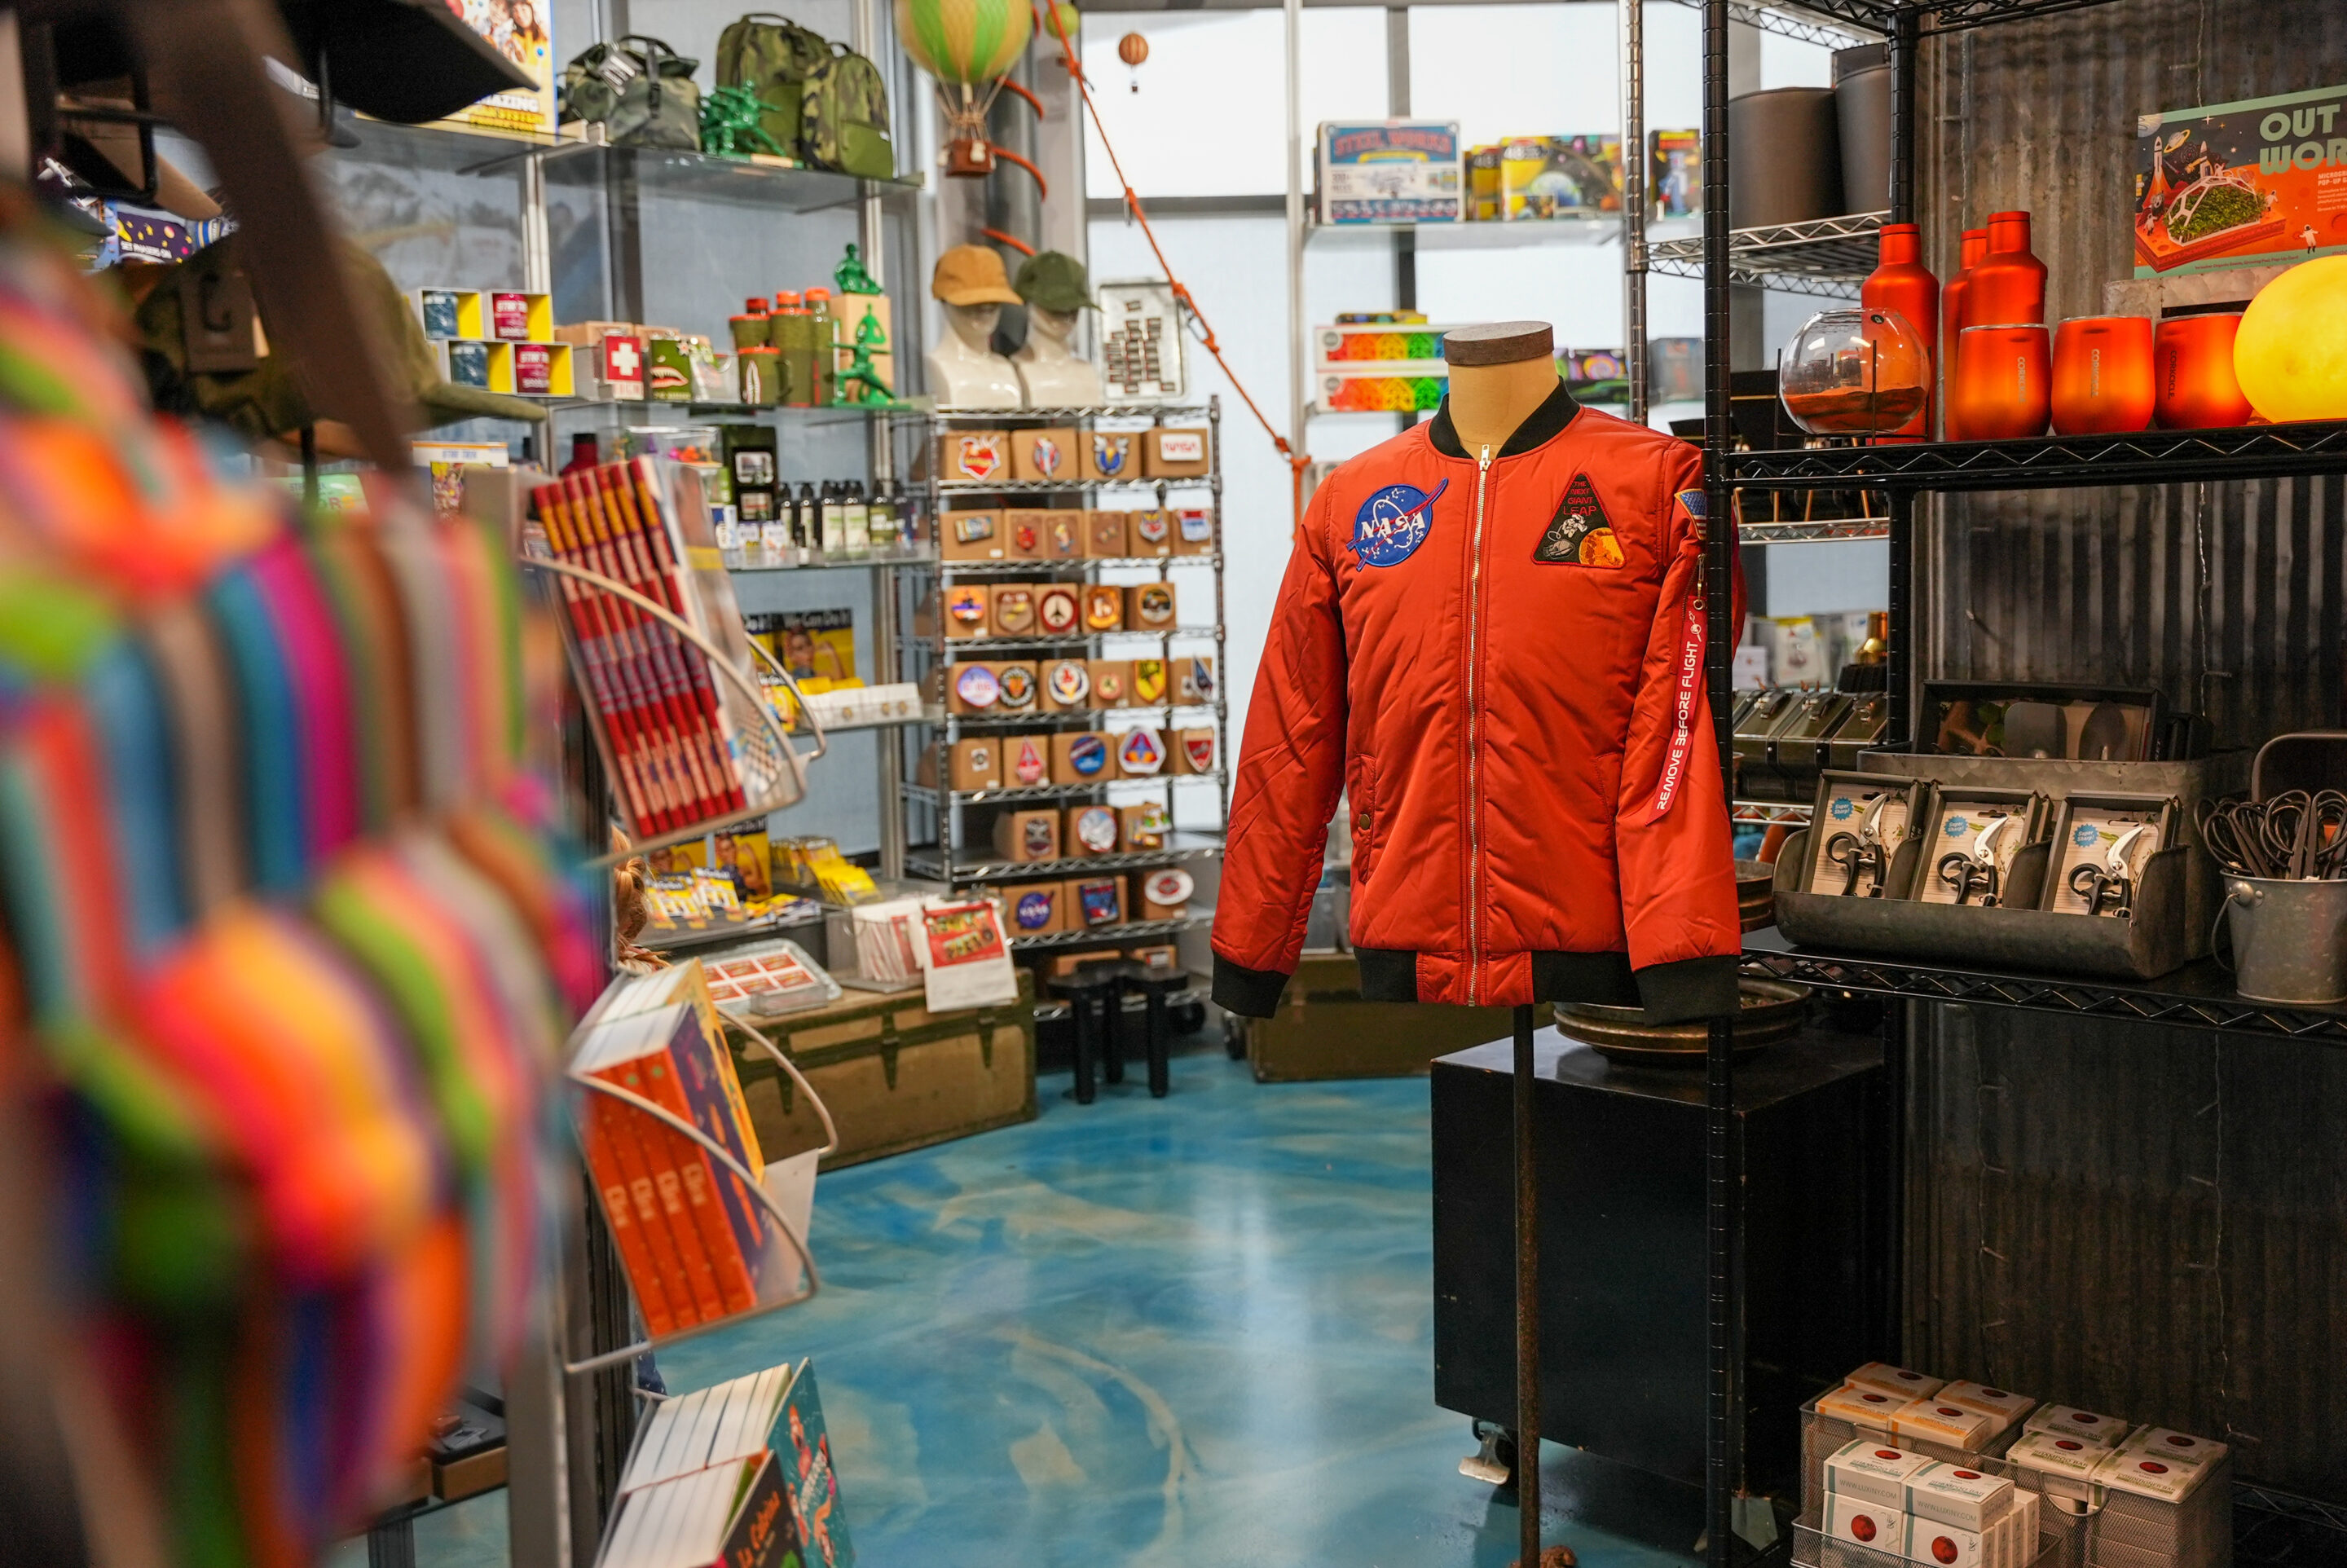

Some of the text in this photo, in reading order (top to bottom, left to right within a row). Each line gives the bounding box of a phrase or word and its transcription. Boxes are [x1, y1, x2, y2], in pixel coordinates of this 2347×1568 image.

[2260, 104, 2340, 141] OUT
[1334, 130, 1452, 156] STEEL WORKS
[2318, 170, 2347, 180] MICROGR
[2318, 178, 2341, 187] POP-UP
[2168, 350, 2177, 400] CORKCICLE
[1563, 505, 1597, 516] LEAP
[1360, 511, 1425, 541] NASA
[1657, 641, 1698, 810] REMOVE BEFORE FLIGHT
[2034, 1450, 2072, 1465] SHAMPOO
[1839, 1478, 1897, 1500] WWW.LUXINY.COM
[1917, 1499, 1977, 1522] WWW.LUXINY.COM
